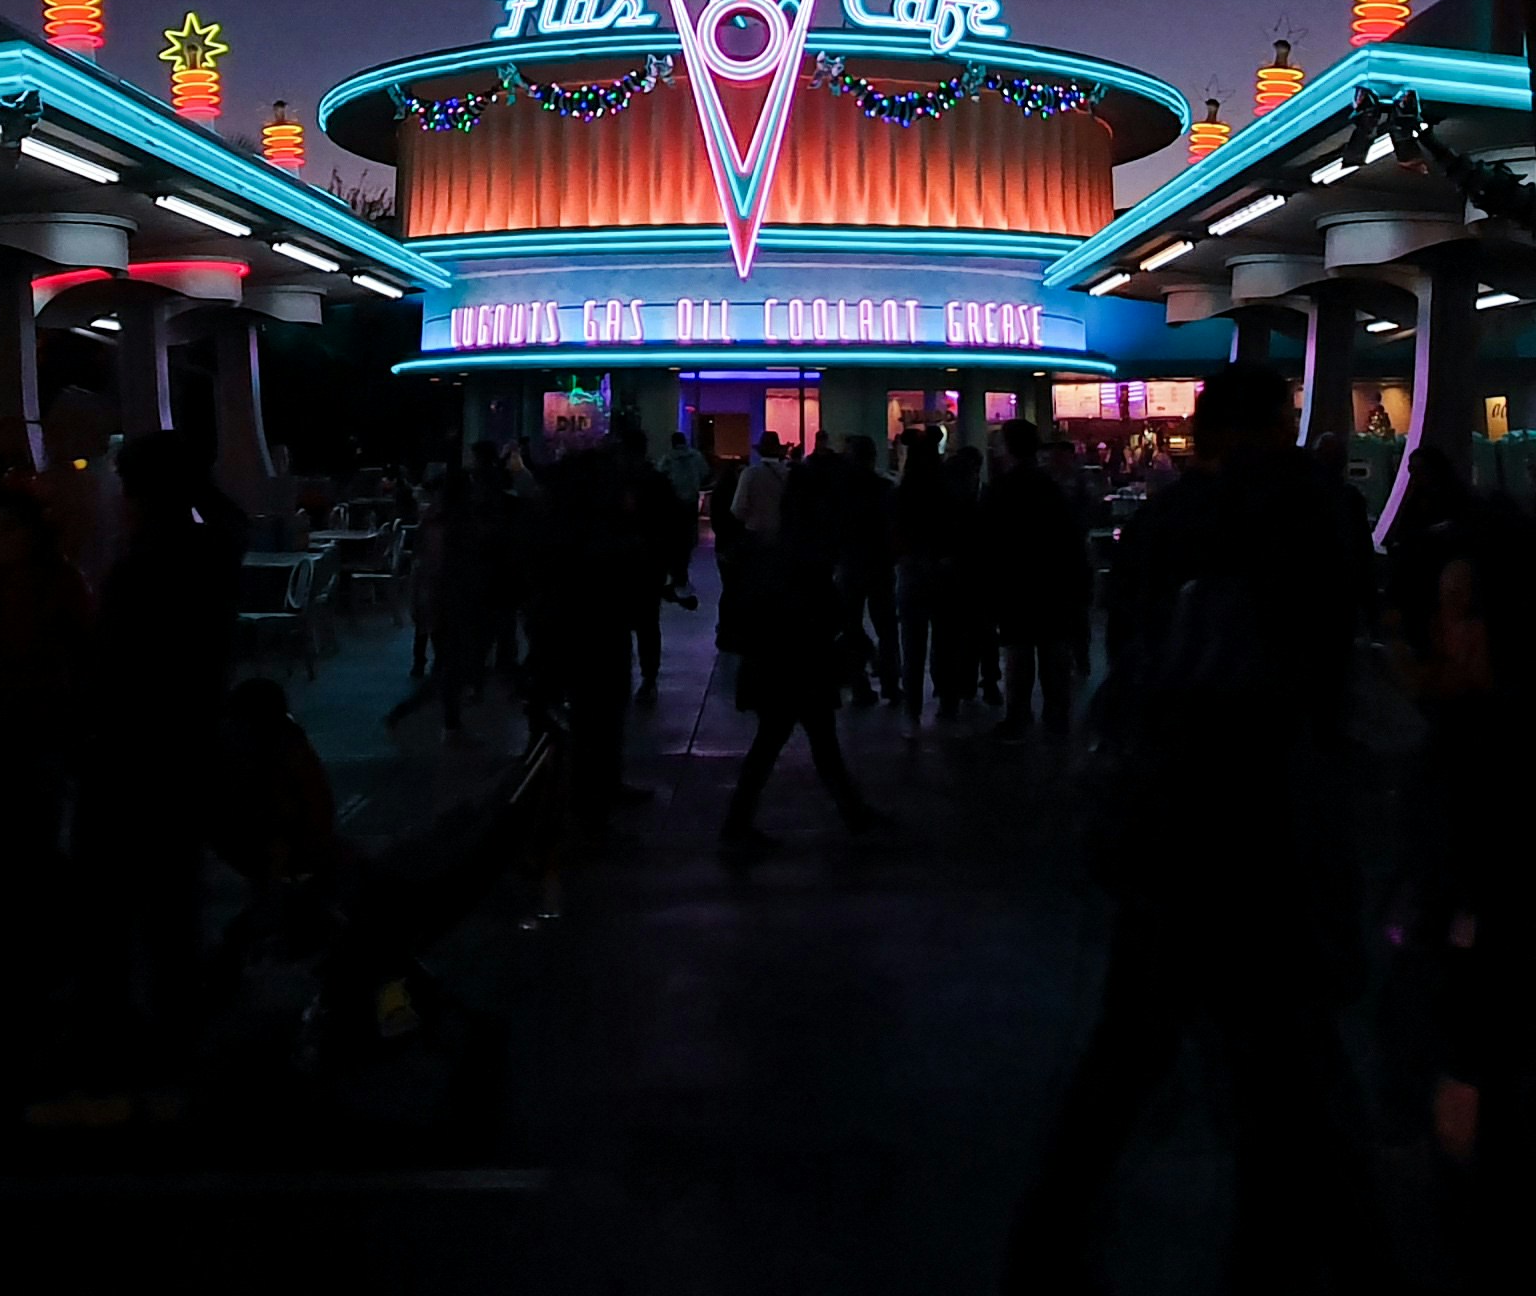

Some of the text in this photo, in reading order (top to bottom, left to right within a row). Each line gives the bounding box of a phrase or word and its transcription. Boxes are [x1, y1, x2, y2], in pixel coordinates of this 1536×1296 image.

[449, 297, 1046, 350] LUGNUTS GAS OIL COOLANT GREASE
